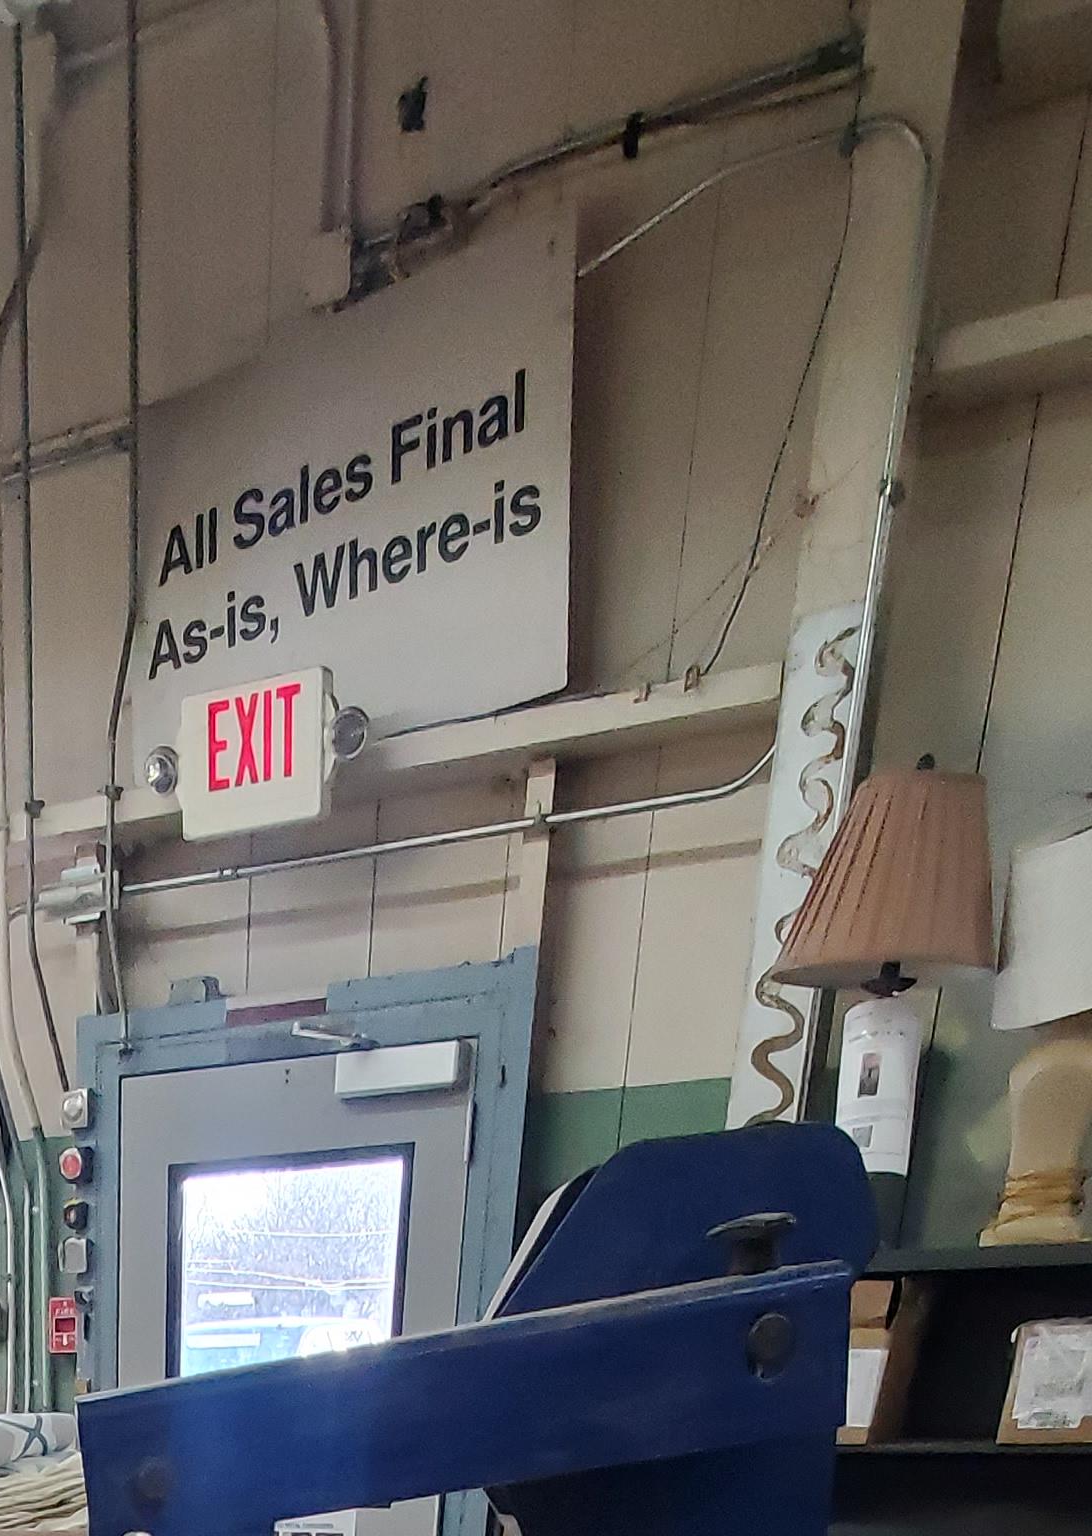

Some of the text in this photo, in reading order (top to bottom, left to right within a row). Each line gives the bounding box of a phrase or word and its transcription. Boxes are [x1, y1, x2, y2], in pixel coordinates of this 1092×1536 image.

[158, 368, 527, 587] All Sales Final
[148, 480, 542, 681] As-is, Where-is
[207, 682, 302, 793] EXIT
